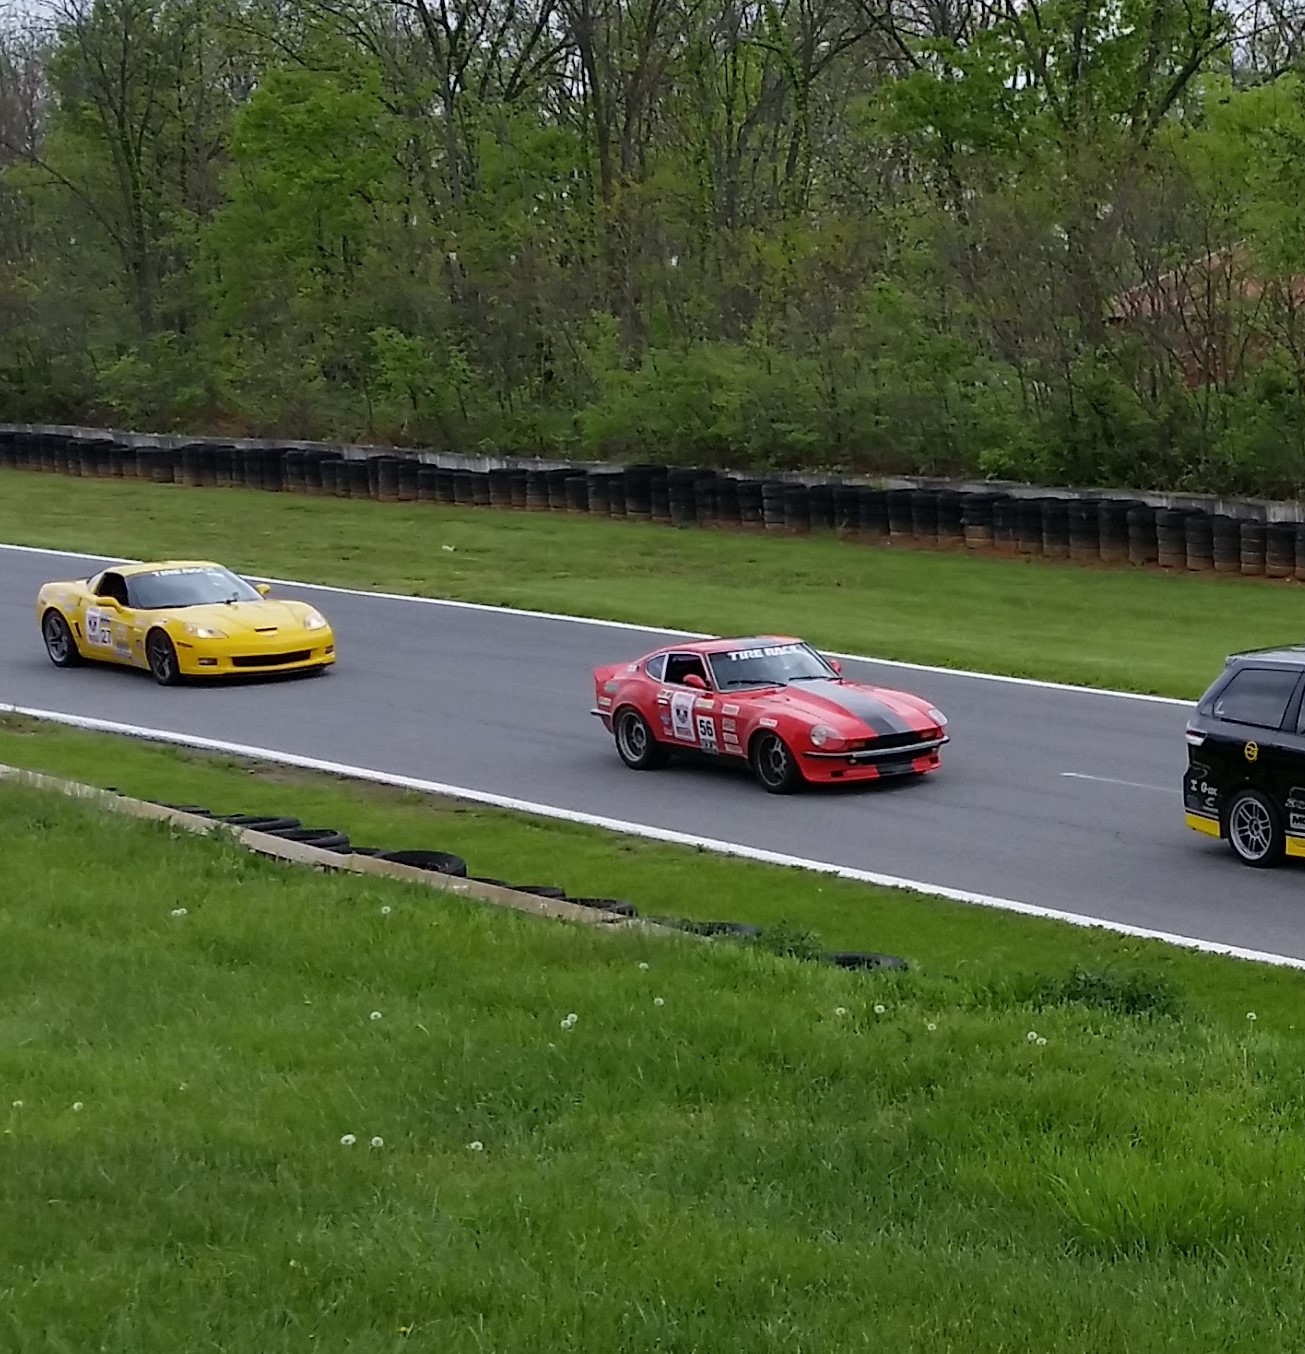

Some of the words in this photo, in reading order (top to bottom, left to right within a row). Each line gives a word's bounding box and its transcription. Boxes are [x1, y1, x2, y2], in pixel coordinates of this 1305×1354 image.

[727, 649, 763, 661] TIRE
[764, 645, 800, 656] RACK
[699, 719, 714, 737] 56
